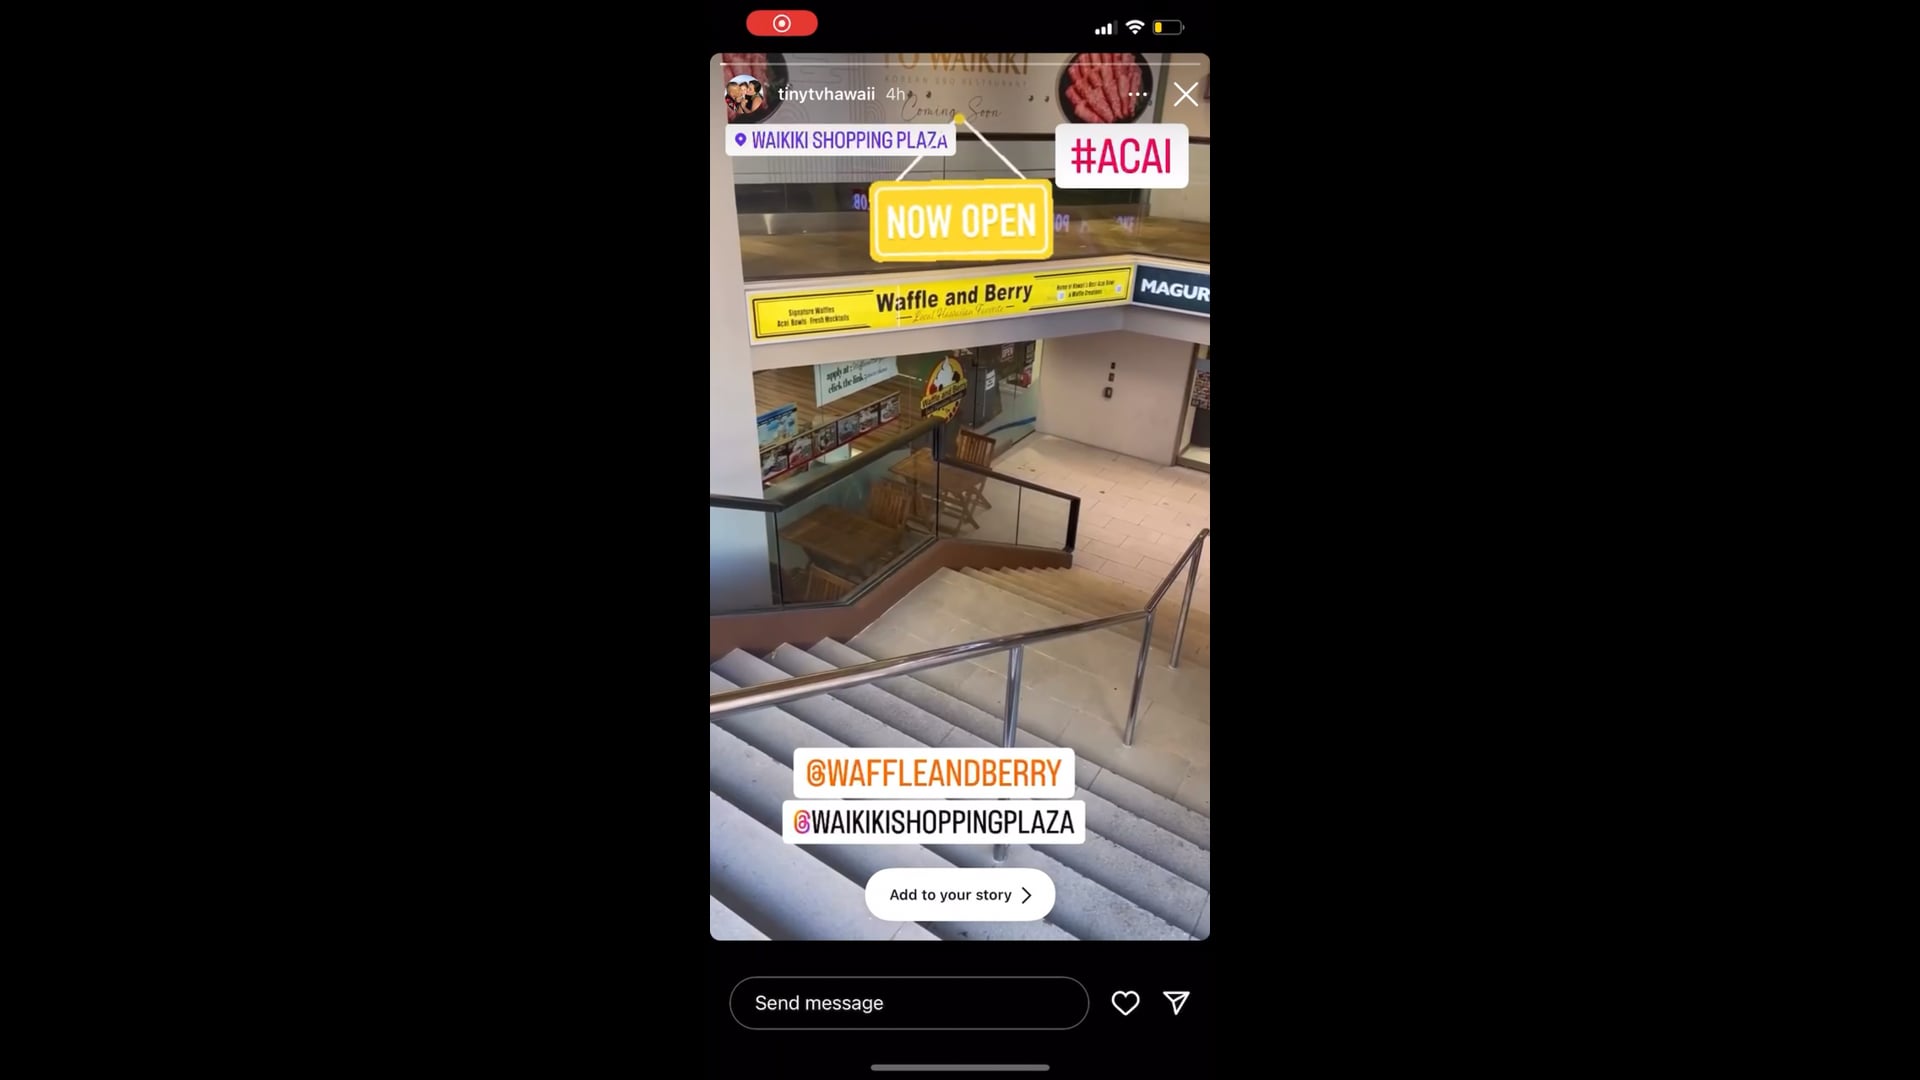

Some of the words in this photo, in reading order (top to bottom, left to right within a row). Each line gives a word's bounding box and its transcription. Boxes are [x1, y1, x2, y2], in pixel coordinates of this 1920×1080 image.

[930, 53, 1029, 75] WAIKIKI
[902, 94, 957, 121] Coming
[967, 96, 1002, 119] Soon
[876, 289, 939, 313] Waffle
[945, 285, 979, 307] and
[985, 283, 1033, 303] Berry
[1140, 278, 1210, 302] MAGUR
[788, 309, 814, 317] Signature
[815, 306, 835, 314] Waffles
[826, 366, 842, 382] apply
[828, 381, 843, 394] click
[843, 378, 853, 388] the
[853, 373, 864, 384] link
